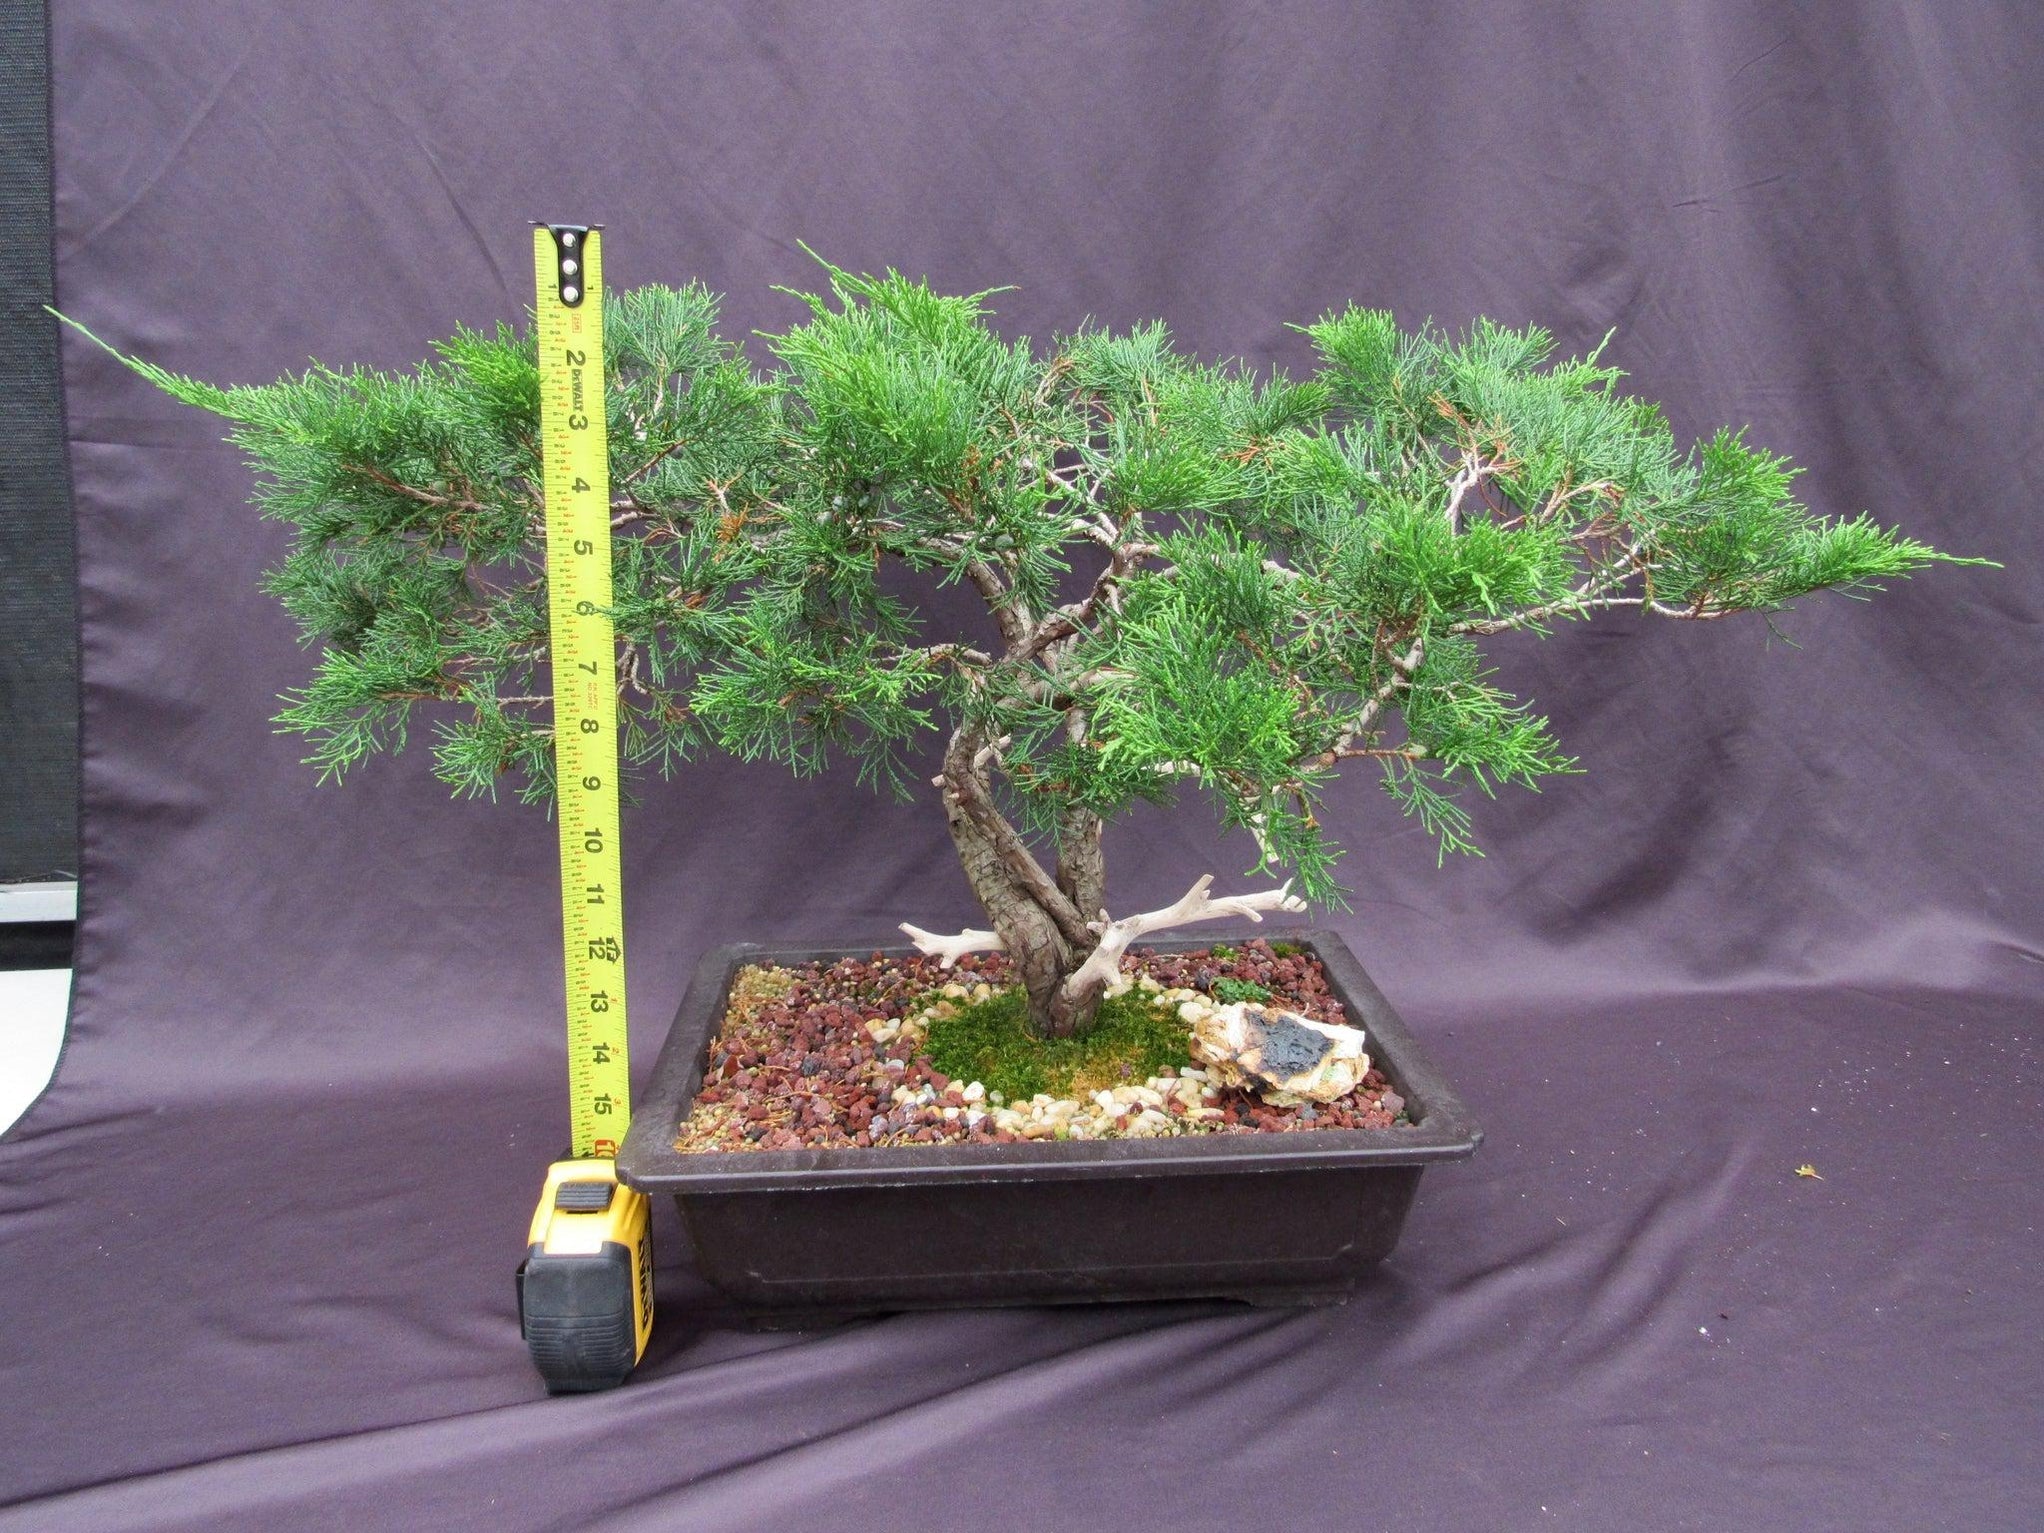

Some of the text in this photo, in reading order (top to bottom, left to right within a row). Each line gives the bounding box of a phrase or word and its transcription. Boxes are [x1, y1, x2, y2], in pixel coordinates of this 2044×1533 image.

[566, 349, 586, 366] 2
[569, 414, 588, 431] 3
[571, 477, 591, 494] 4
[573, 539, 593, 556] 5
[576, 600, 595, 617] 6
[578, 661, 598, 676] 7
[580, 718, 599, 734] 8
[582, 775, 601, 791] 9
[584, 827, 603, 854] 10
[586, 883, 605, 905] 11
[588, 937, 606, 960] 12
[590, 990, 609, 1013] 13
[592, 1042, 611, 1065] 14
[594, 1093, 612, 1115] 15
